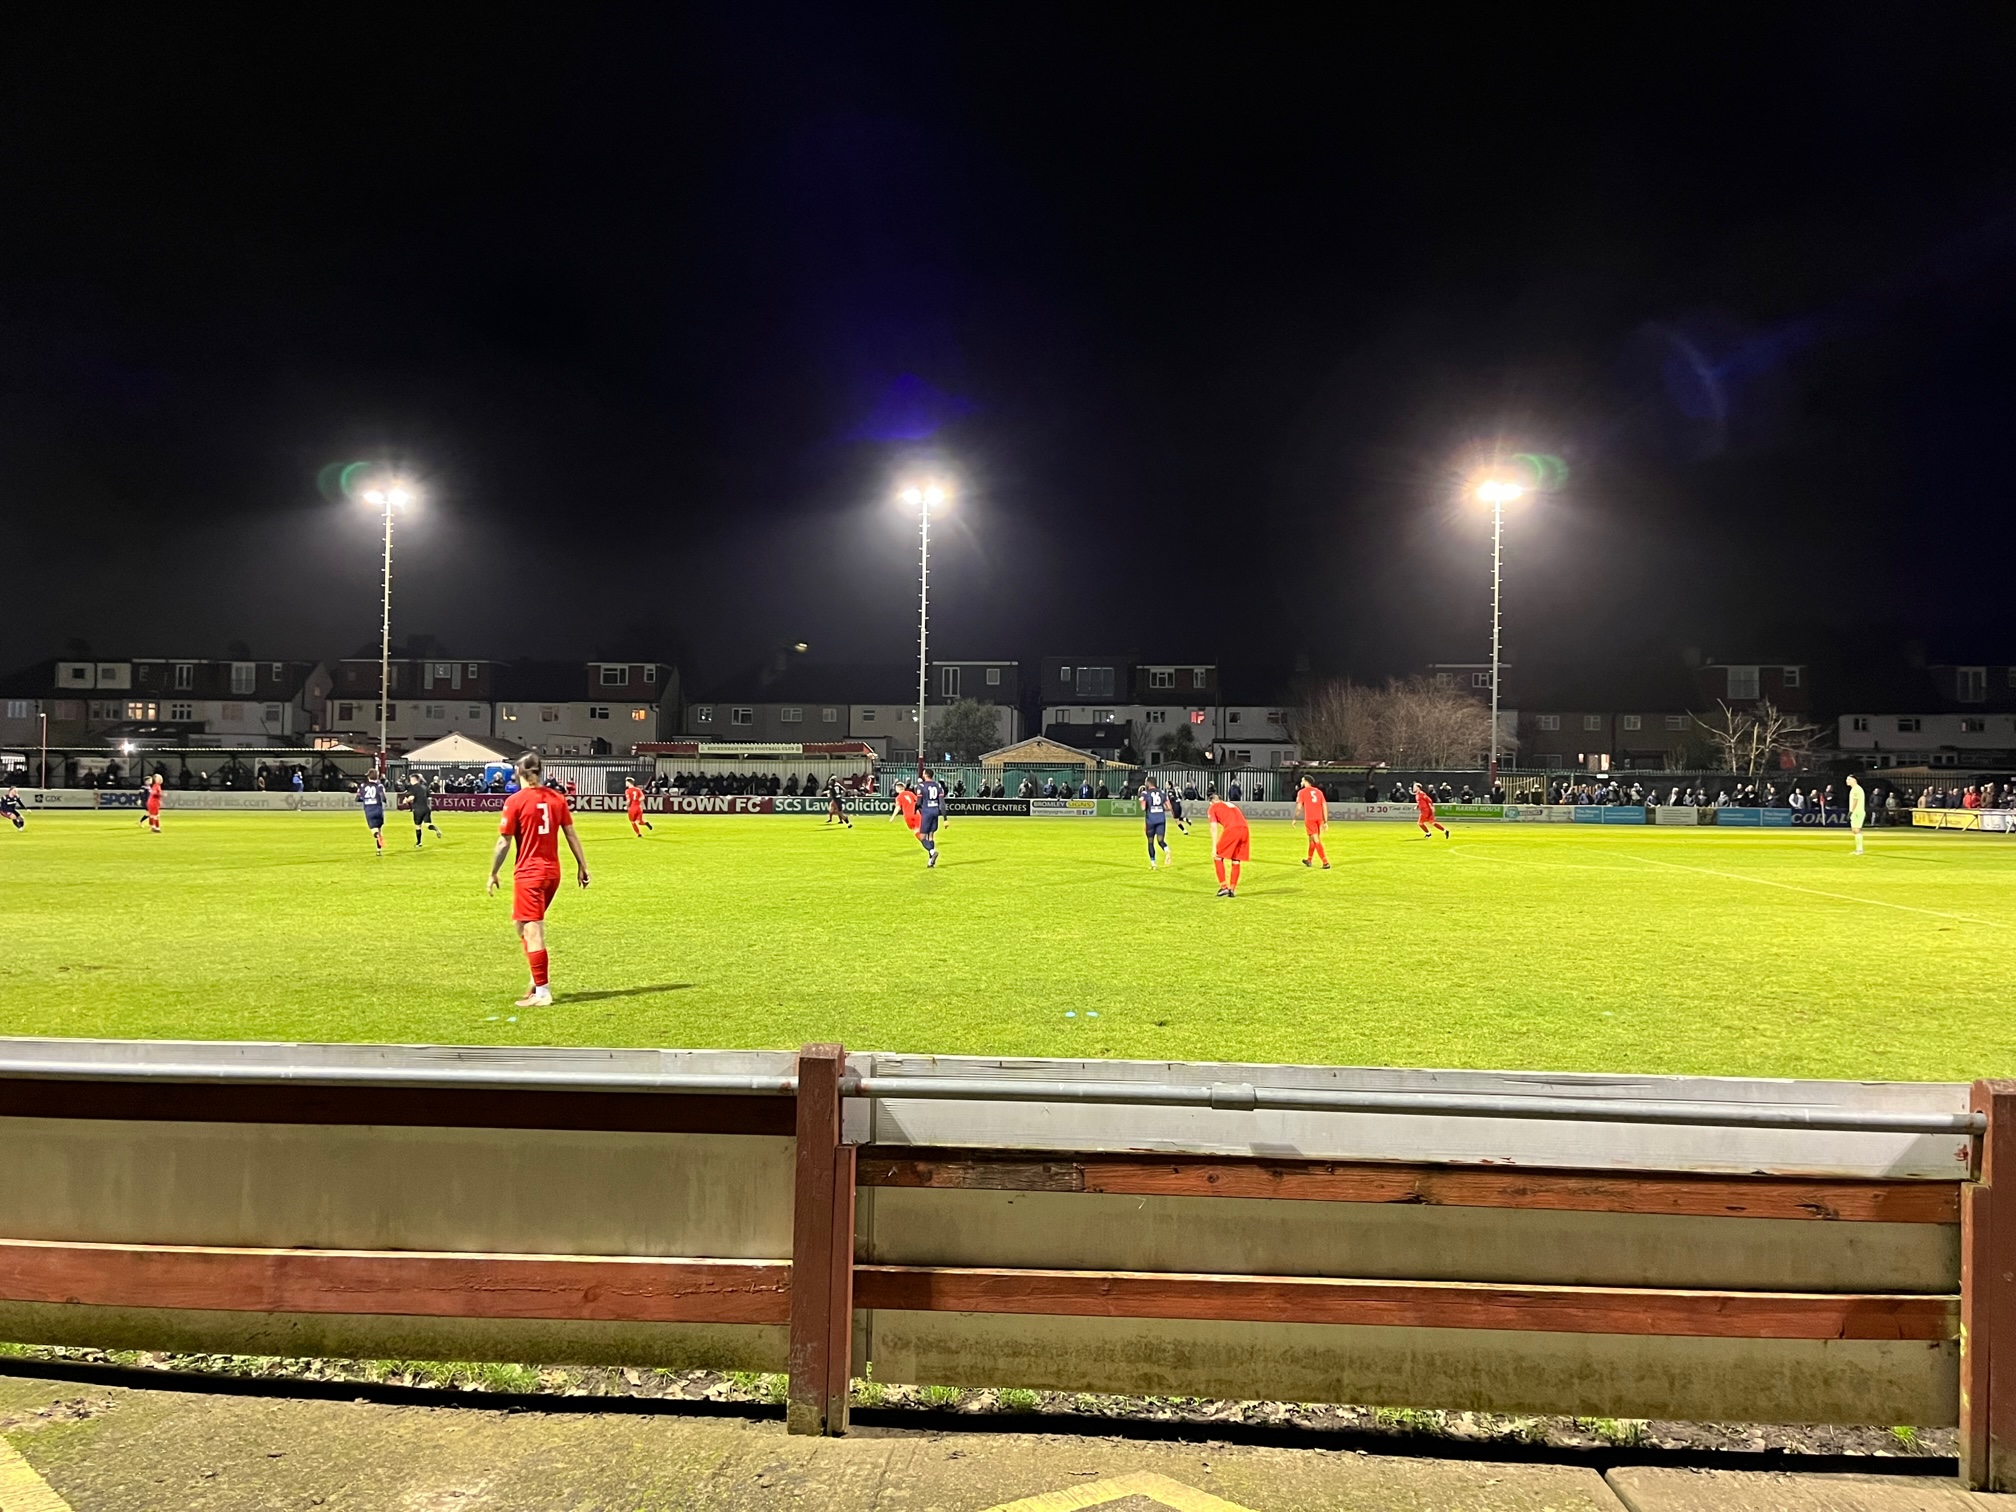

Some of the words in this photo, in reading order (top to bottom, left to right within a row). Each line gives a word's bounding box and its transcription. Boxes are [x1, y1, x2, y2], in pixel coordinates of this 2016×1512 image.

[364, 785, 377, 798] 20
[927, 785, 938, 799] 10
[1310, 790, 1318, 803] 5
[443, 798, 476, 807] ESTATE
[669, 797, 729, 812] TOWN
[735, 798, 761, 813] FC
[775, 799, 802, 811] SCS
[805, 799, 830, 811] Law
[1150, 791, 1162, 806] 16
[945, 803, 991, 811] ECORATING
[992, 804, 1027, 812] CENTRES
[536, 802, 550, 835] 3
[1791, 813, 1848, 824] CORAL
